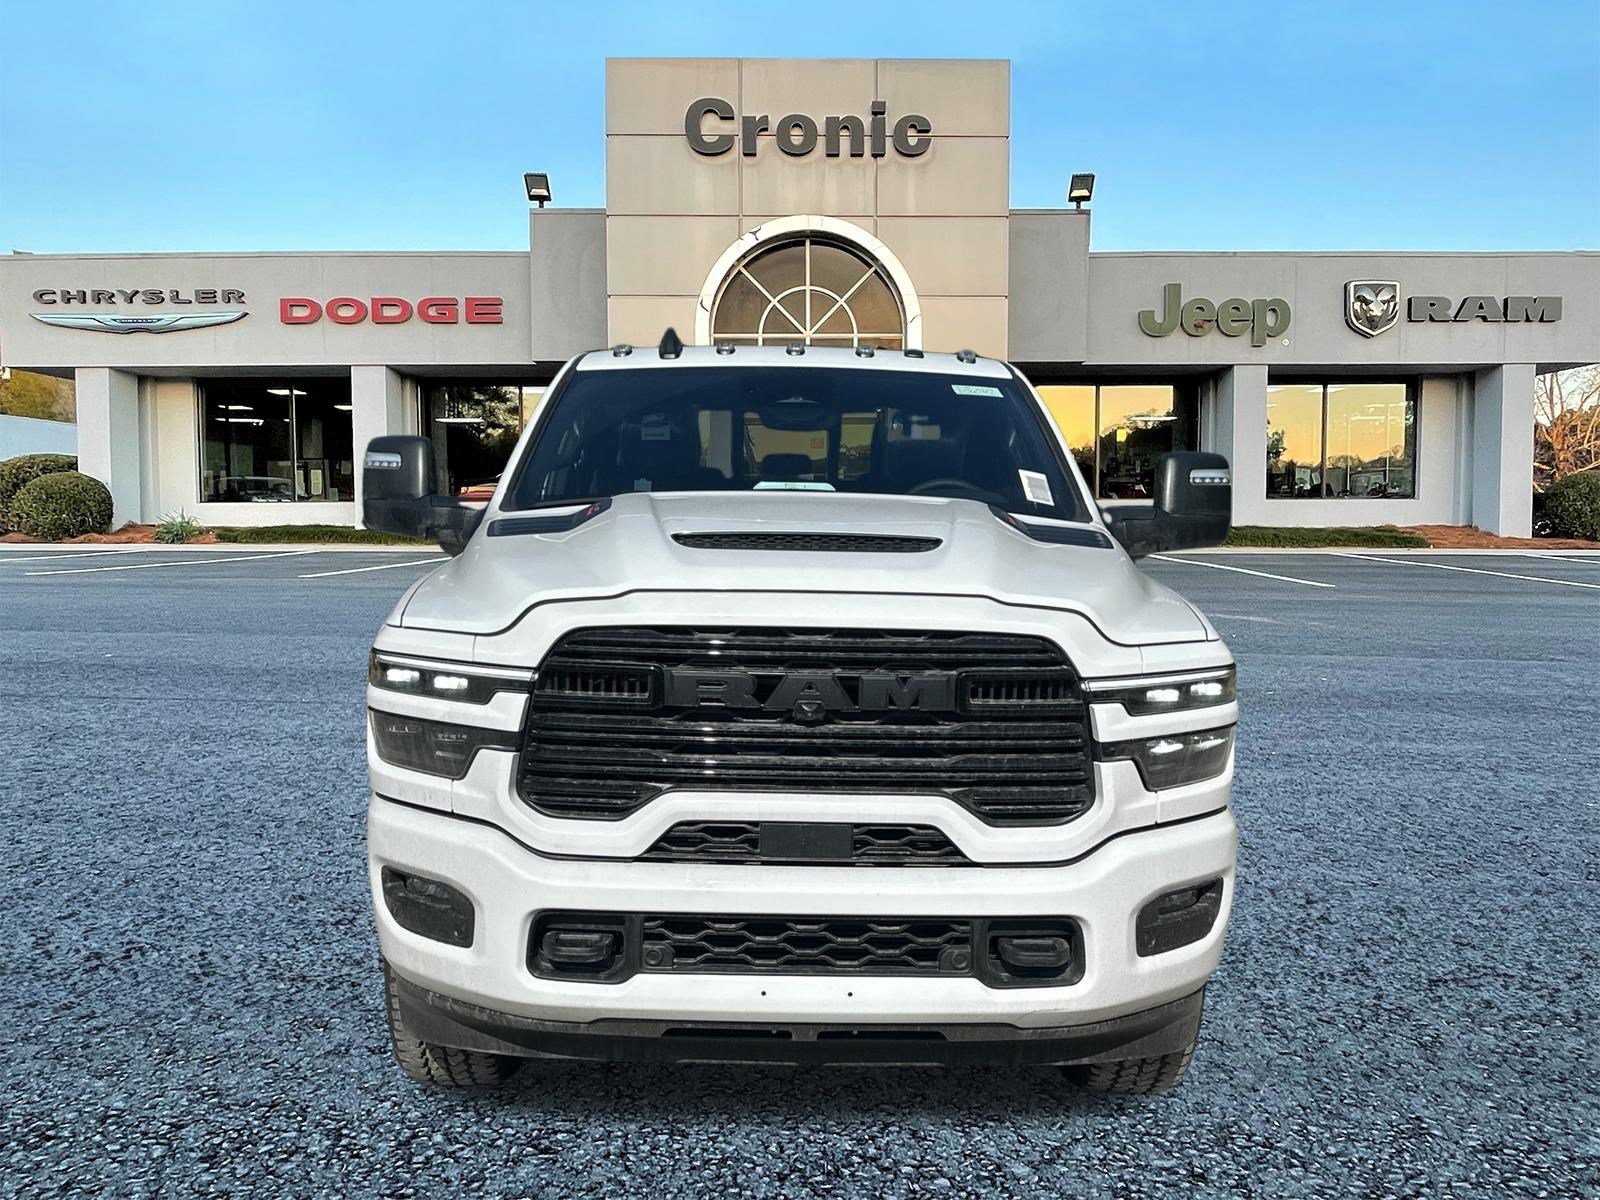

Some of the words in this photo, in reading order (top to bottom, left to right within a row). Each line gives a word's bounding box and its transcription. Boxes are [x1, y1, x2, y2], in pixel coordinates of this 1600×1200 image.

[685, 97, 932, 157] Cronic
[32, 288, 246, 305] CHRYSLER
[279, 297, 503, 324] DODGE
[1407, 296, 1562, 322] RAM
[1138, 283, 1291, 347] Jeep
[667, 671, 957, 711] RAM
